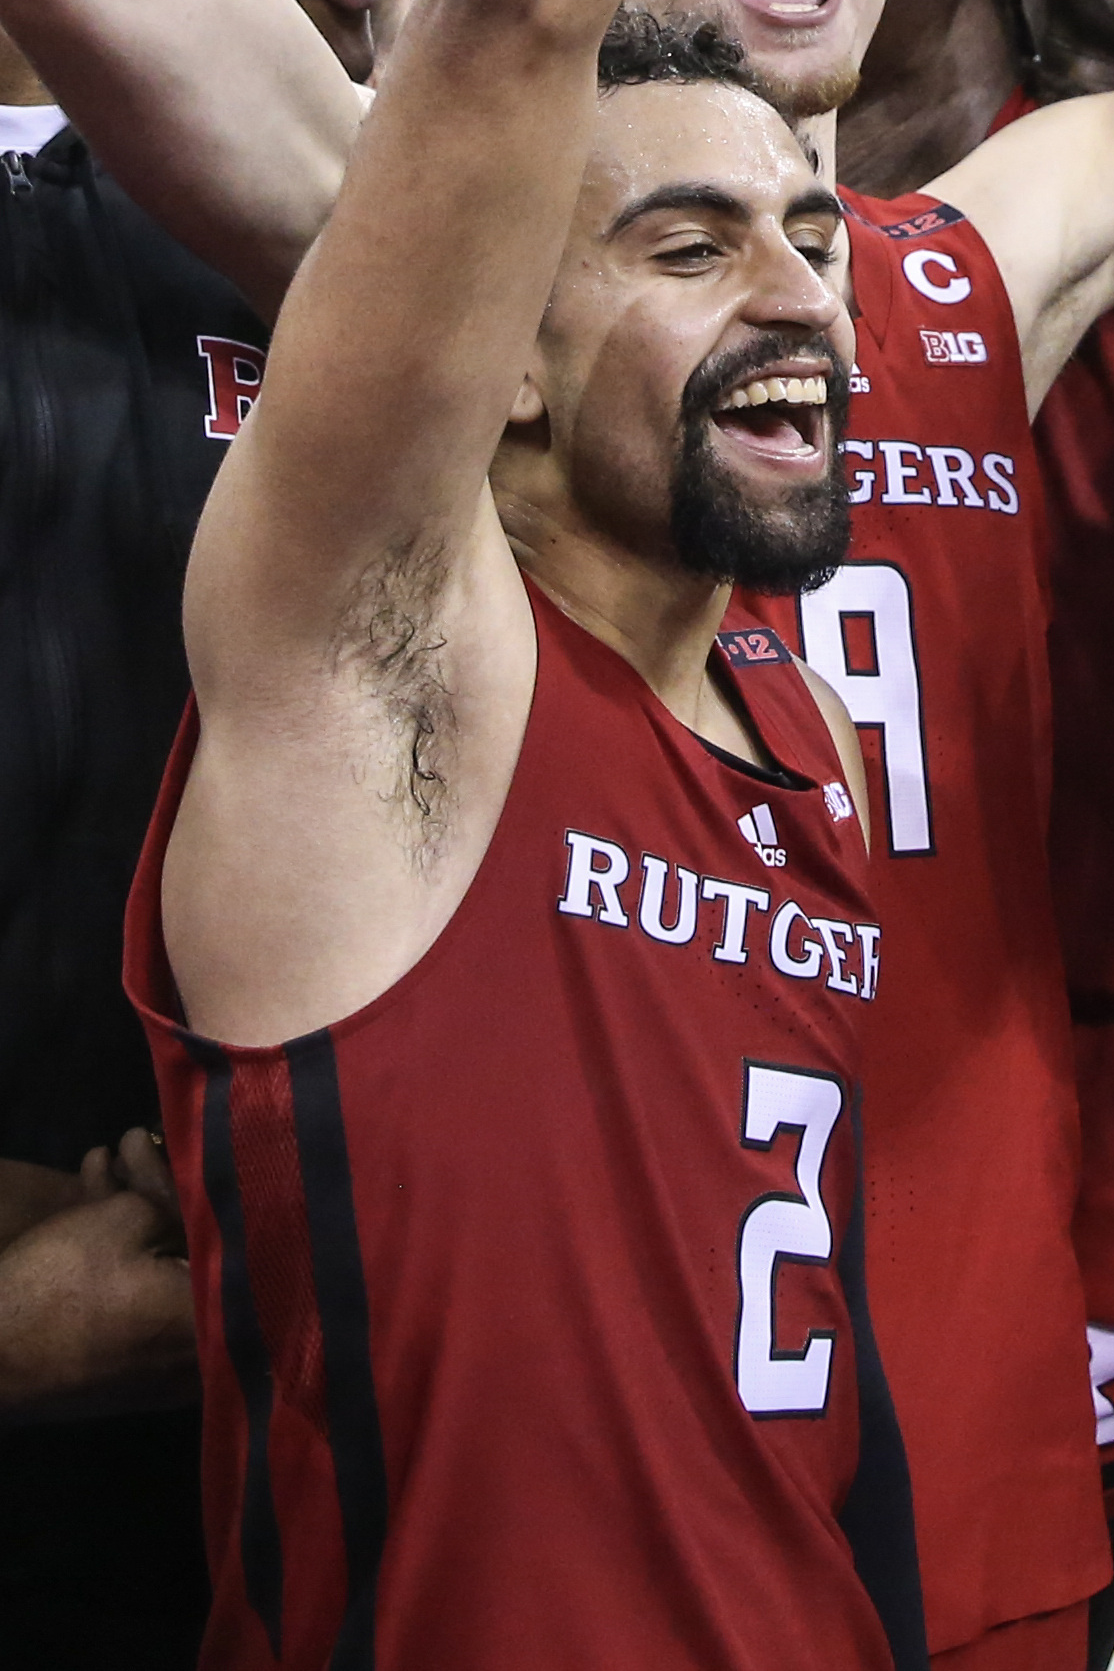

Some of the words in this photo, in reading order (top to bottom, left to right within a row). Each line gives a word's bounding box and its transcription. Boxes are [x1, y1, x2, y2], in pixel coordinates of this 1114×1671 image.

[902, 248, 973, 305] C
[844, 439, 1020, 515] GERS
[734, 1057, 846, 1419] 2
